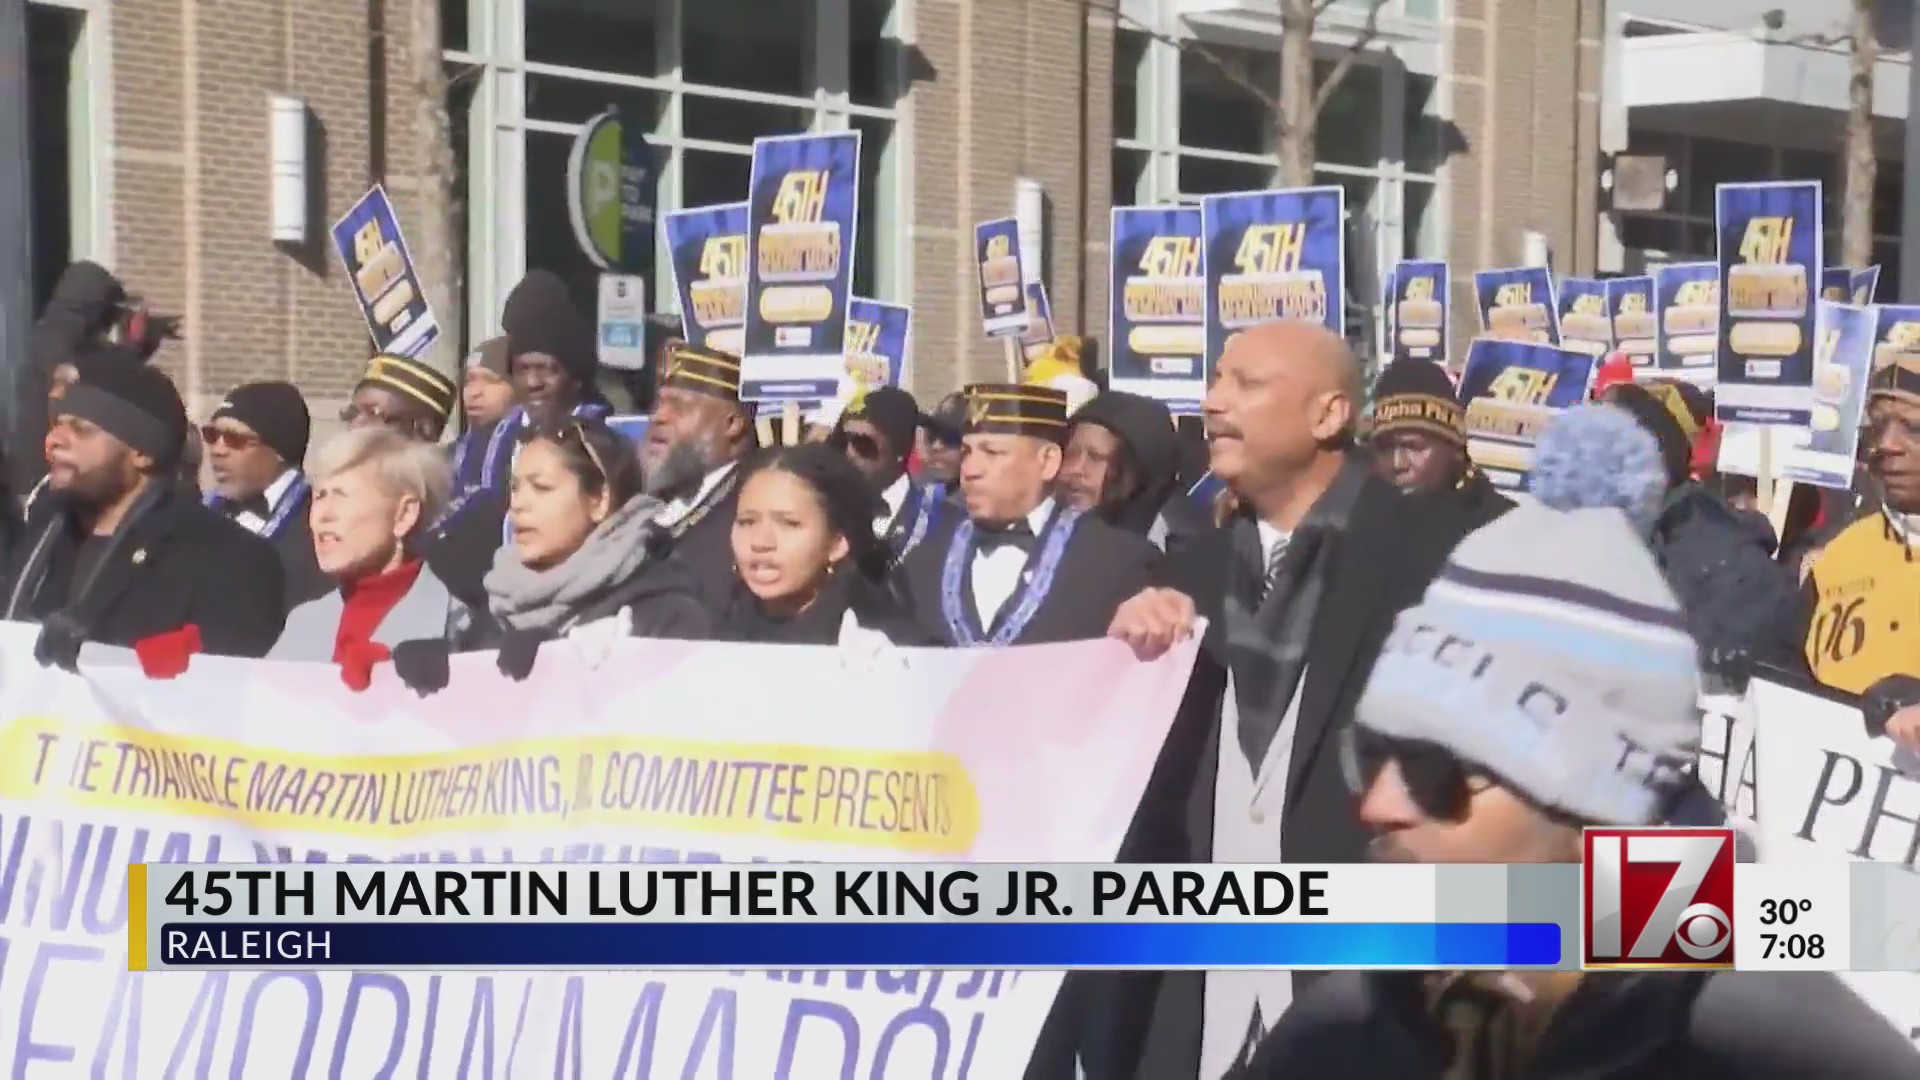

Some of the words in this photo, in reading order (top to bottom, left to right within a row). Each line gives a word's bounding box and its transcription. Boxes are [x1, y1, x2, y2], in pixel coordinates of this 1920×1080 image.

[771, 170, 830, 223] 45TH
[1139, 236, 1201, 277] 45TH
[1235, 223, 1306, 274] 45TH
[1488, 366, 1558, 406] 45TH
[112, 742, 247, 808] TRIANGLE
[246, 760, 387, 825] MARTIN
[389, 764, 483, 825] LUTHER
[480, 754, 568, 821] KING,
[601, 749, 808, 824] COMMITTEE
